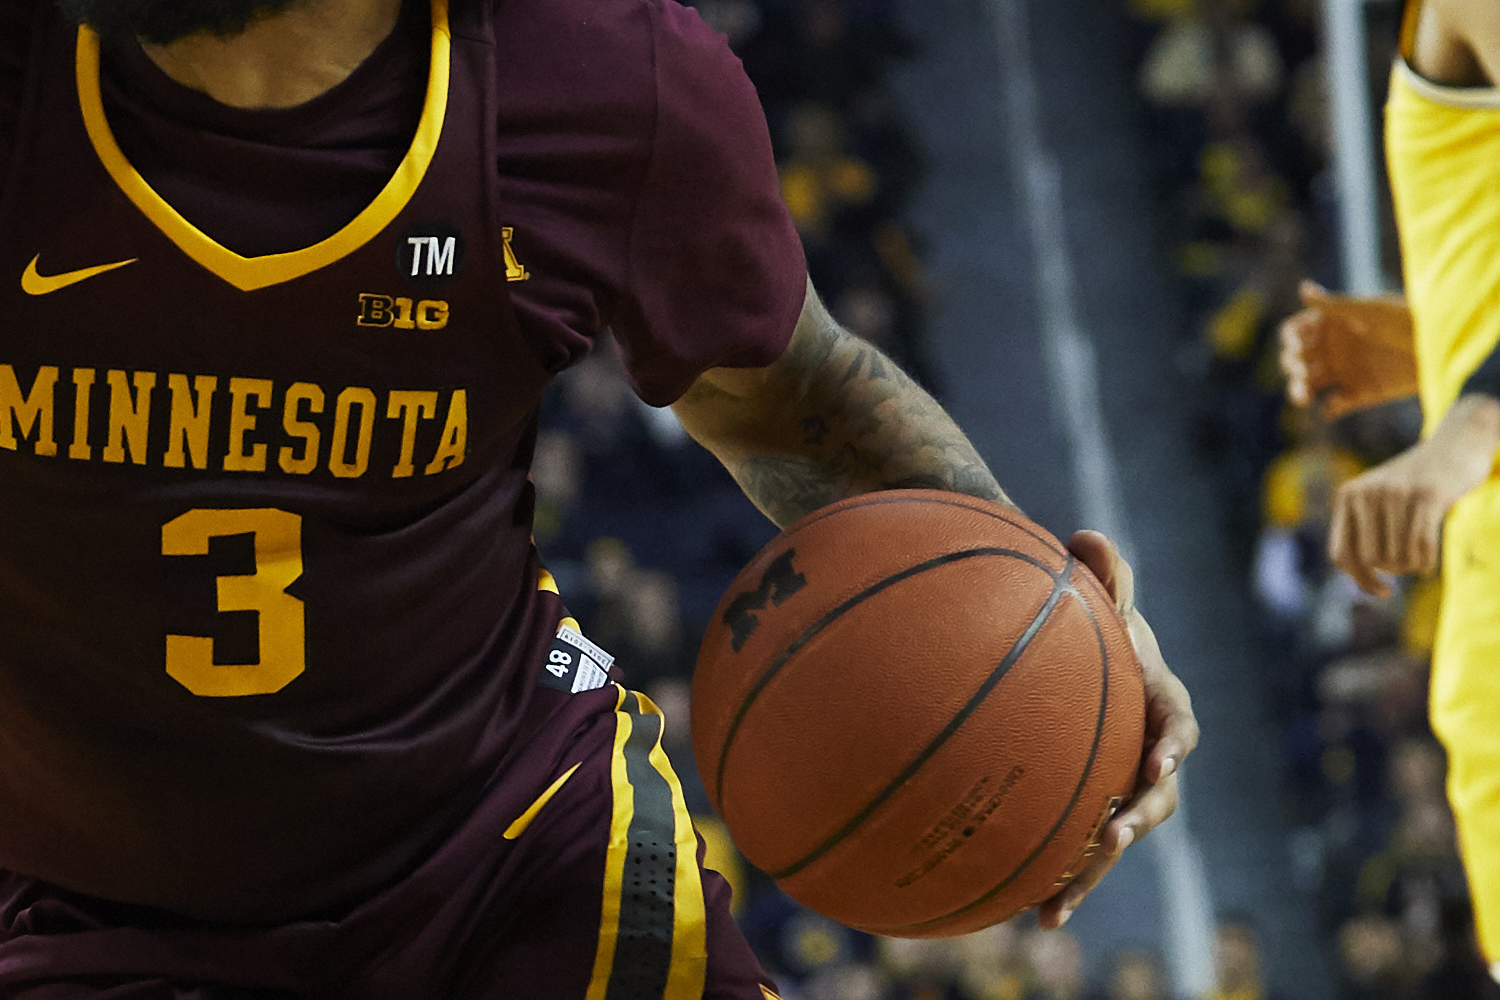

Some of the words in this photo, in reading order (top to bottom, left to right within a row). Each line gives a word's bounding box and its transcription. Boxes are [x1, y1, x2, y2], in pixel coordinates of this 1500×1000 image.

[407, 236, 456, 277] TM
[161, 507, 305, 697] 3
[545, 650, 572, 678] 48
